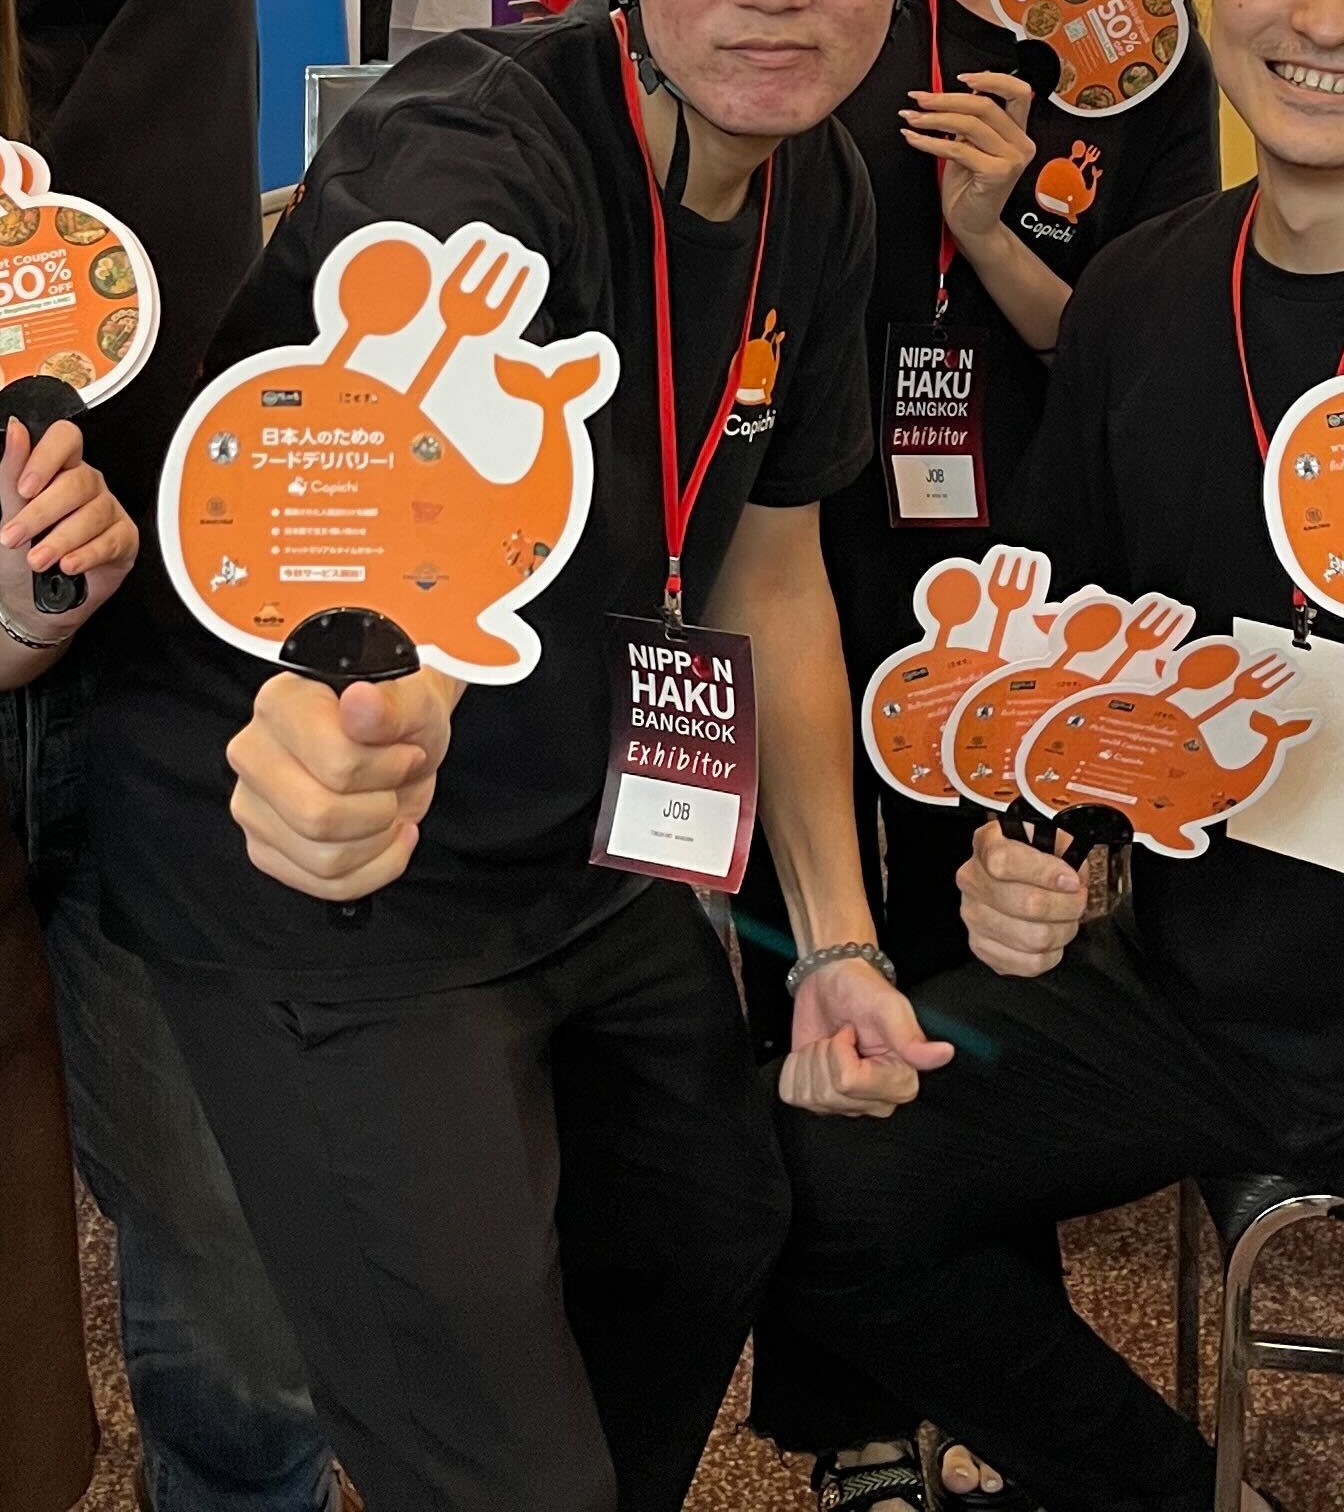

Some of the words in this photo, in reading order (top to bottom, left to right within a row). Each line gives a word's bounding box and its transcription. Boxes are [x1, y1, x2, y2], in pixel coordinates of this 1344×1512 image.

[13, 248, 67, 266] Coupon
[48, 282, 73, 295] OFF
[897, 371, 972, 399] HAKU
[896, 401, 968, 417] BANGKOK
[262, 428, 385, 446] 日本人のための
[893, 428, 968, 447] Exhibitor
[251, 451, 395, 470] フードデリバリー!
[925, 468, 945, 484] JOB
[311, 480, 358, 497] Capichi
[631, 673, 736, 719] HAKU
[631, 709, 736, 744] BANGKOK
[627, 741, 737, 776] Exhibitor
[662, 800, 691, 822] JOB
